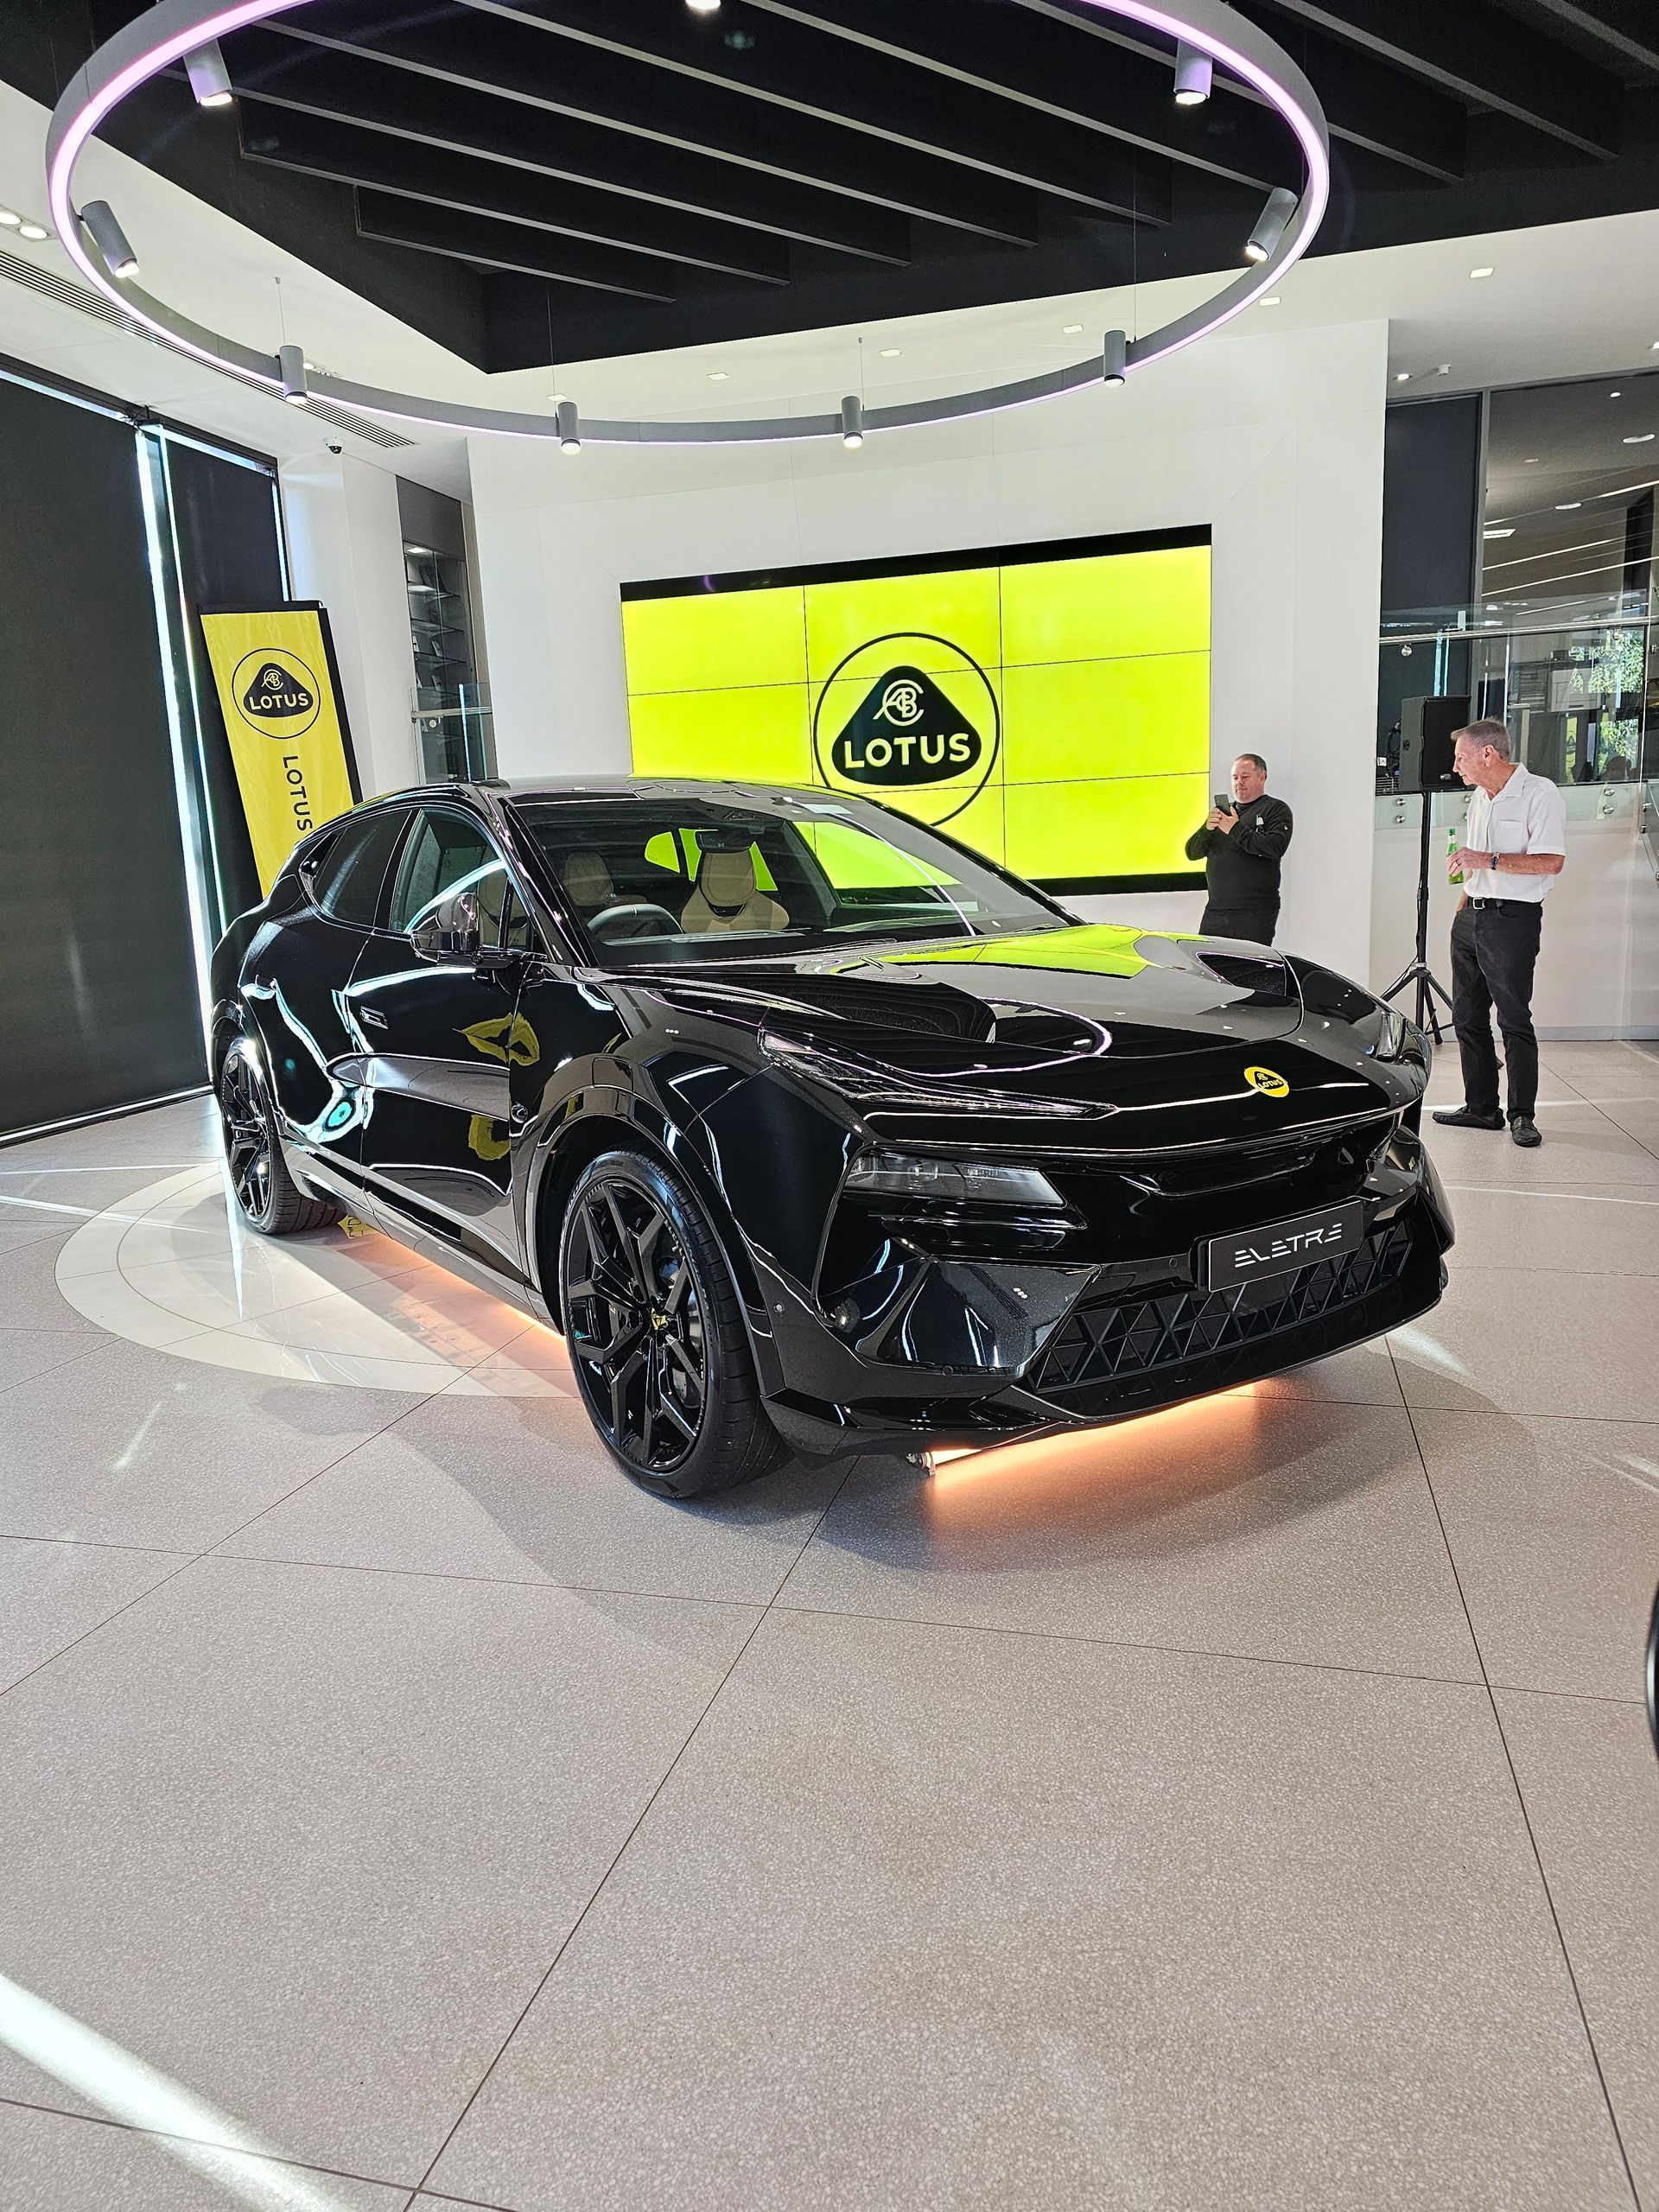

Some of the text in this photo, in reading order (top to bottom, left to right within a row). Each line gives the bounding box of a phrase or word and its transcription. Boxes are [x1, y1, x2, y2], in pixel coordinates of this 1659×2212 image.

[249, 692, 309, 710] LOTUS
[844, 733, 971, 769] LOTUS
[283, 755, 313, 831] LOTUS
[1257, 1079, 1283, 1090] LOTUS
[1235, 1223, 1343, 1268] ELETRE
